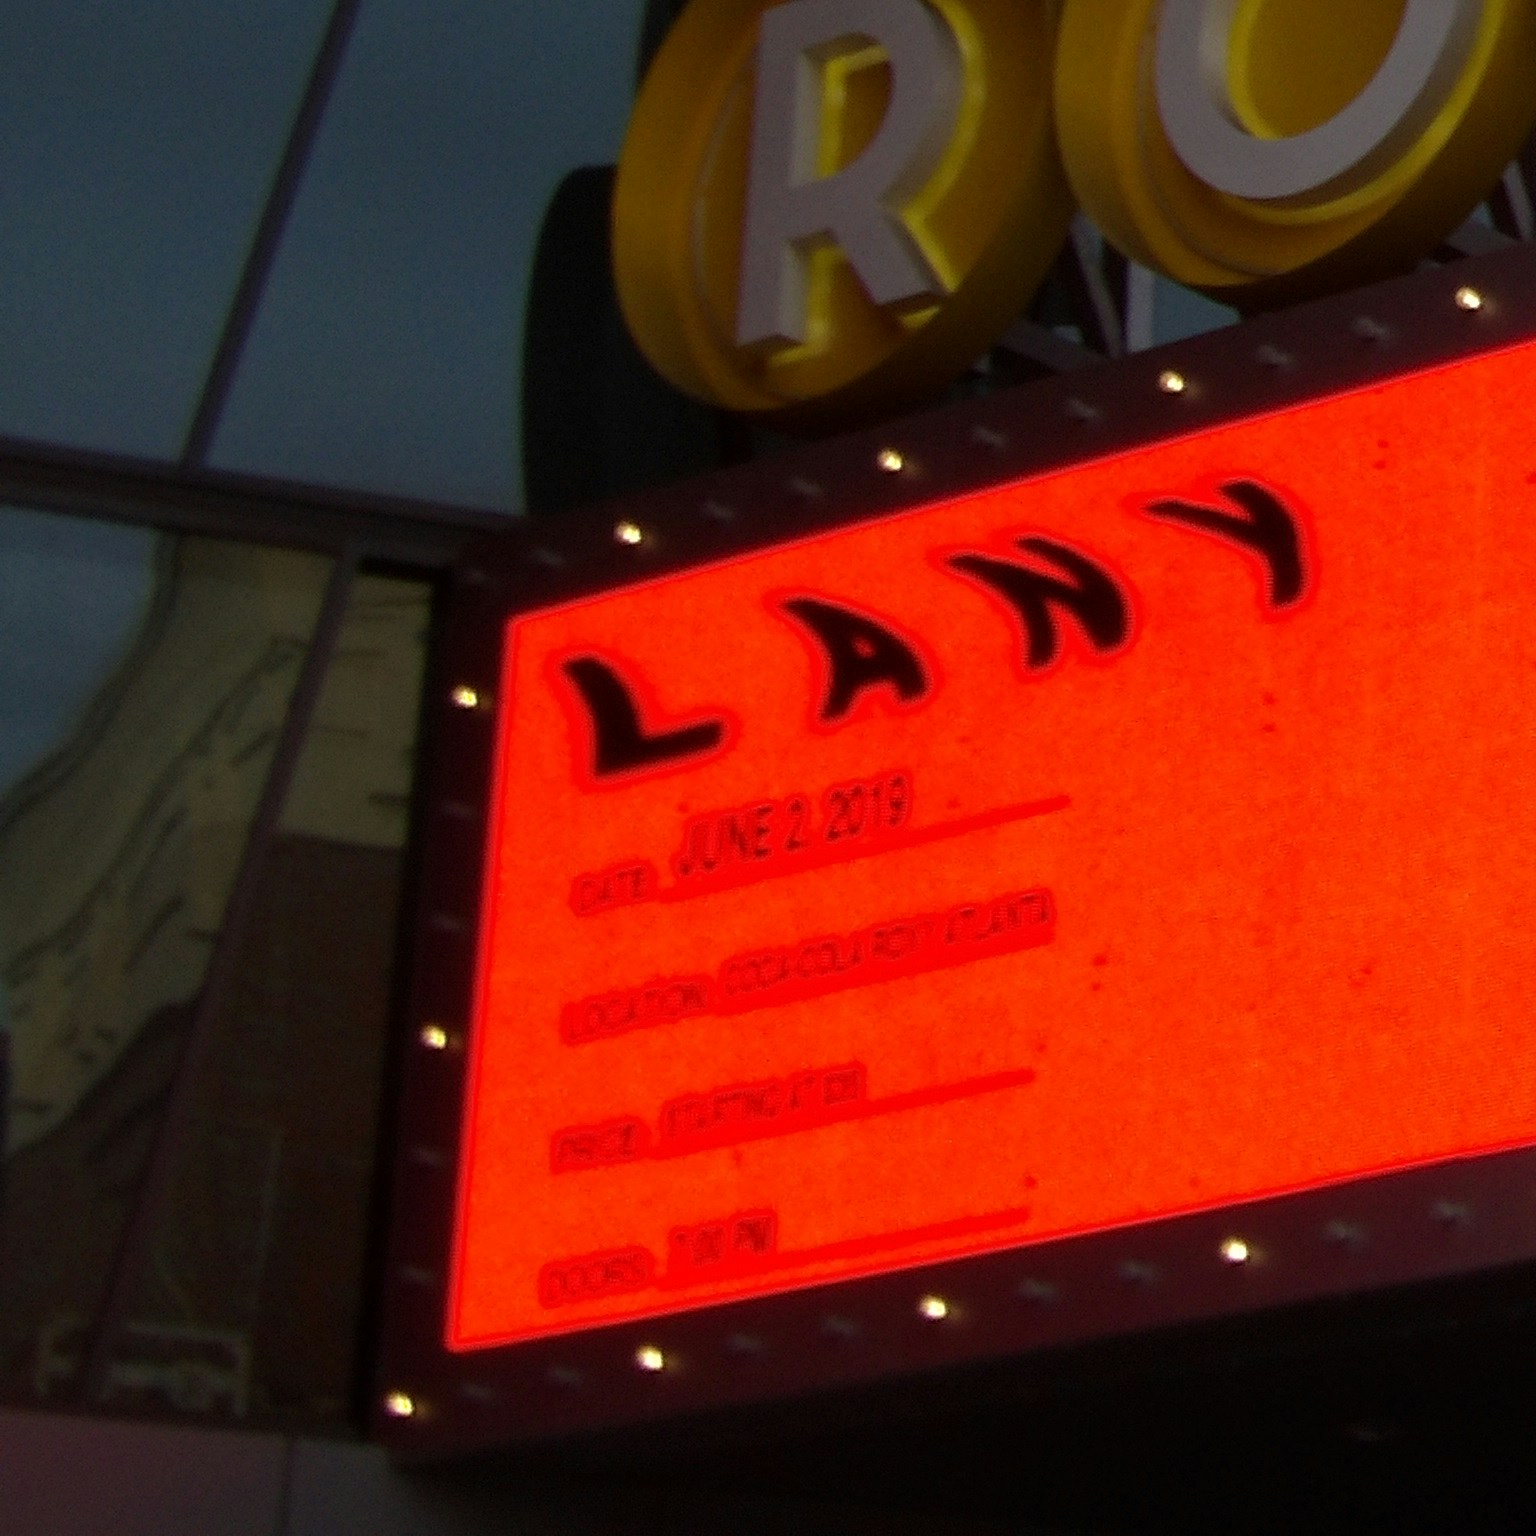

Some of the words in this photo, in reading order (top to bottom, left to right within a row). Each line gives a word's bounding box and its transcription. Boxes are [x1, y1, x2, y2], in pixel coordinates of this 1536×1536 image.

[562, 478, 1304, 777] LANY
[678, 804, 775, 875] JUNE
[827, 774, 907, 840] 2019
